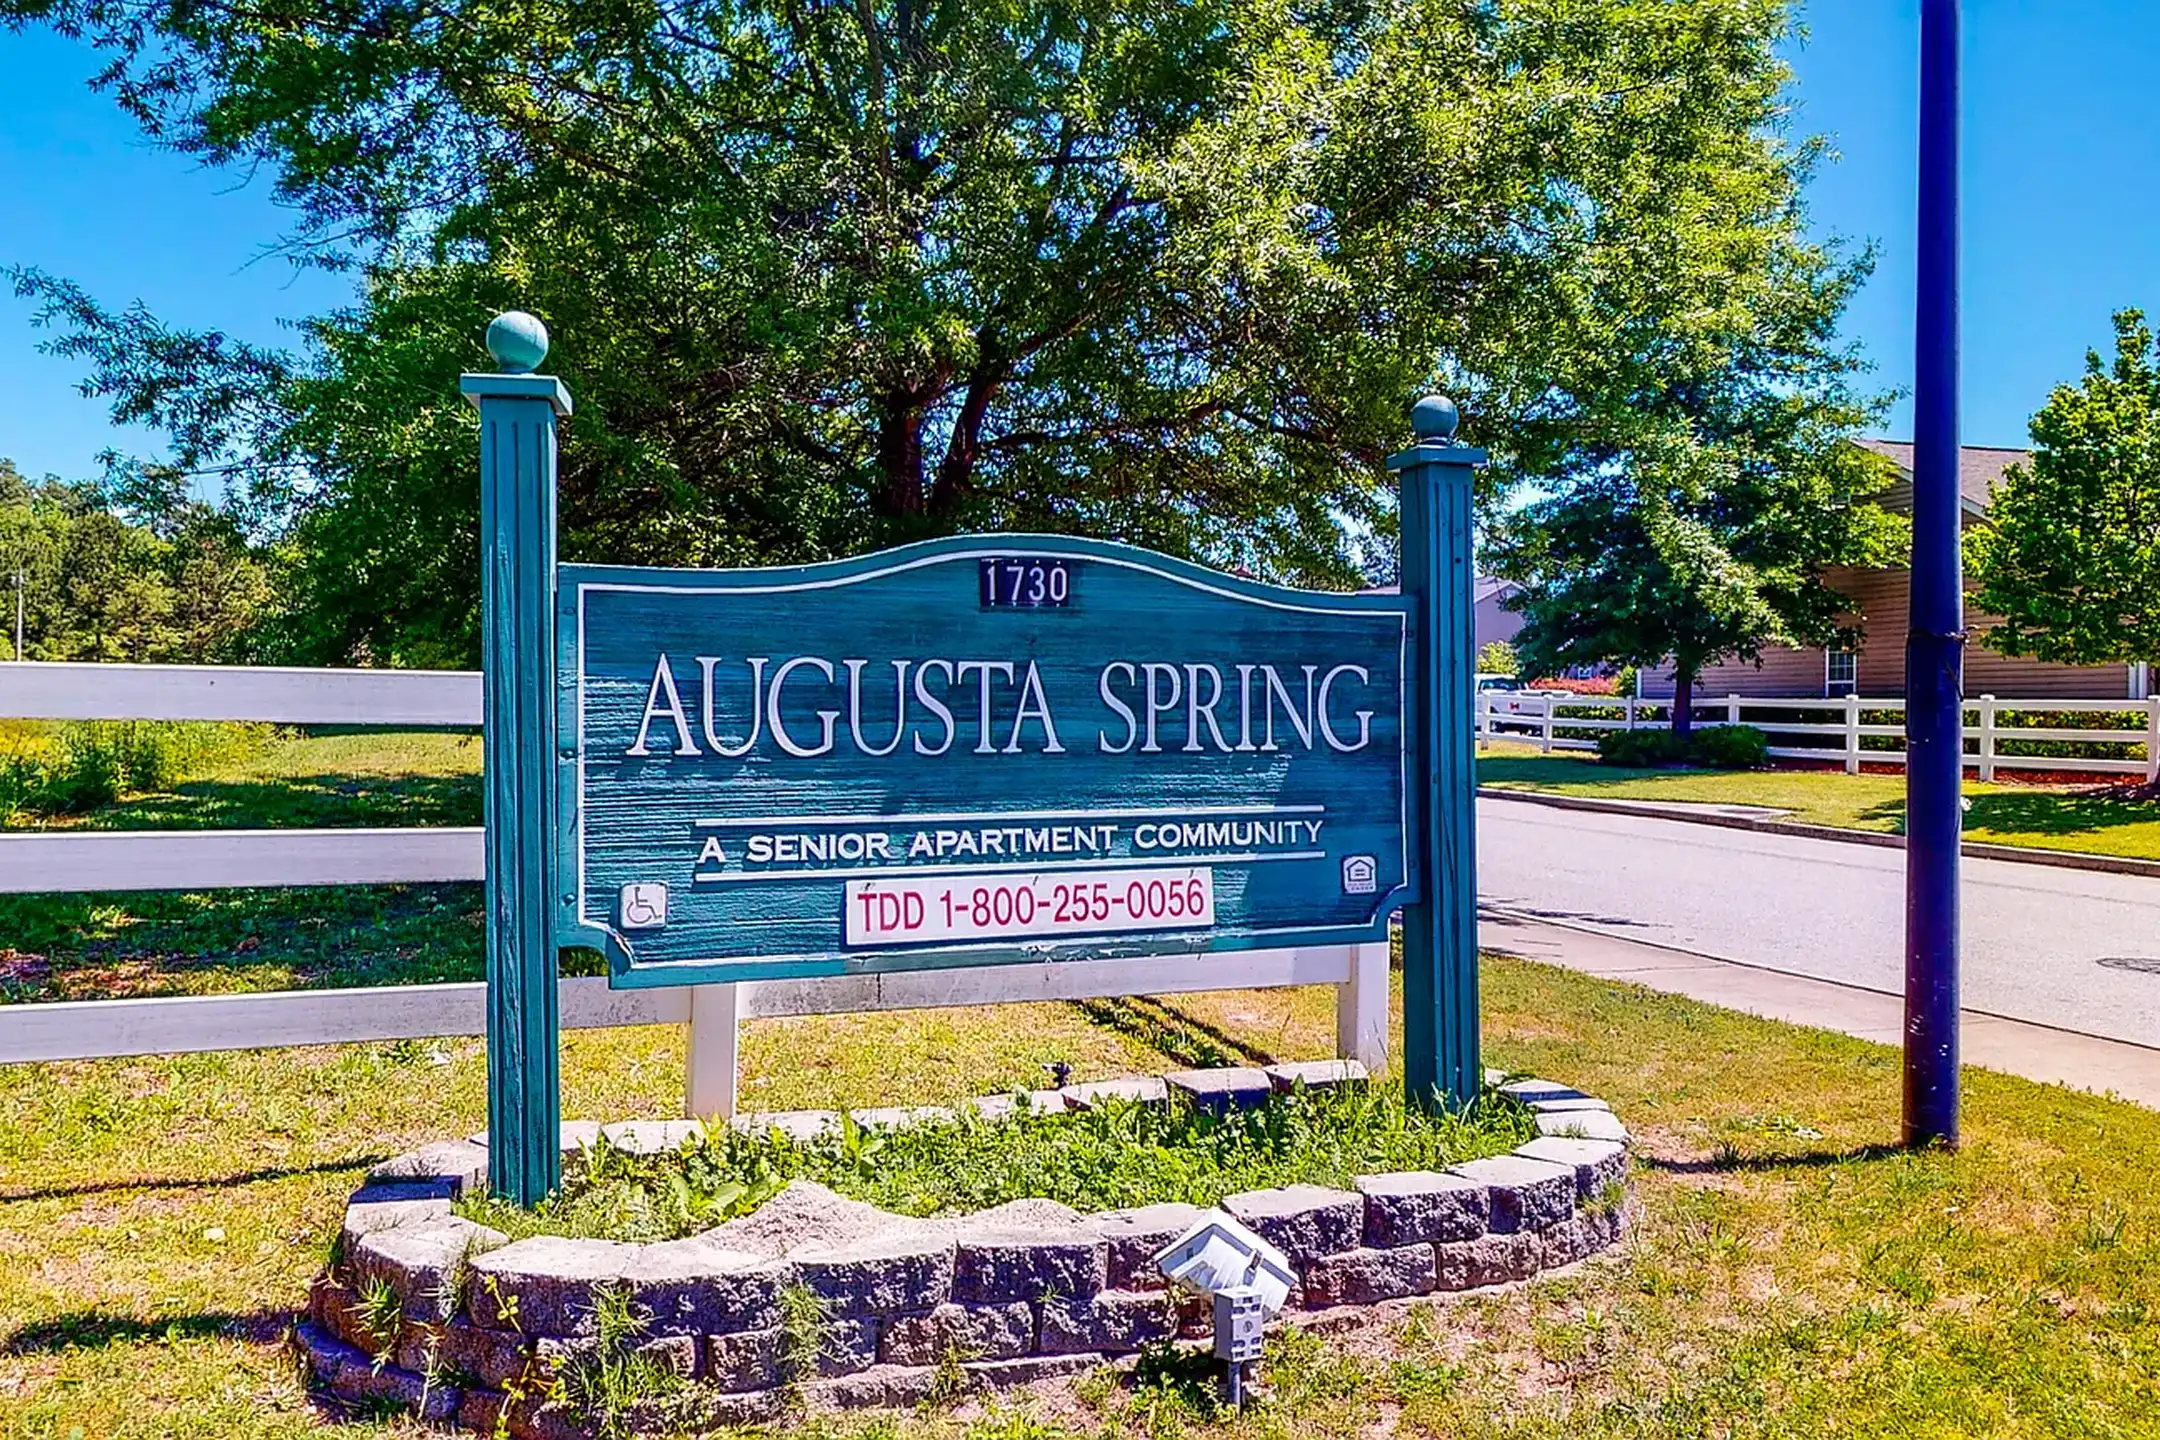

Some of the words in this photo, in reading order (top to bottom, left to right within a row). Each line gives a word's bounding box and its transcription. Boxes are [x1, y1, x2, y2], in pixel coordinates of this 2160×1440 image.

[987, 566, 1067, 601] 1730
[626, 653, 1066, 757] AUGUSTA
[1099, 661, 1374, 754] SPRING
[699, 836, 726, 864] A
[746, 832, 890, 862] SENIOR
[908, 825, 1118, 858] APARTMENT
[1134, 820, 1324, 849] COMMUNITY
[857, 891, 924, 933] TDD
[940, 878, 1204, 928] 1-800-255-0056
